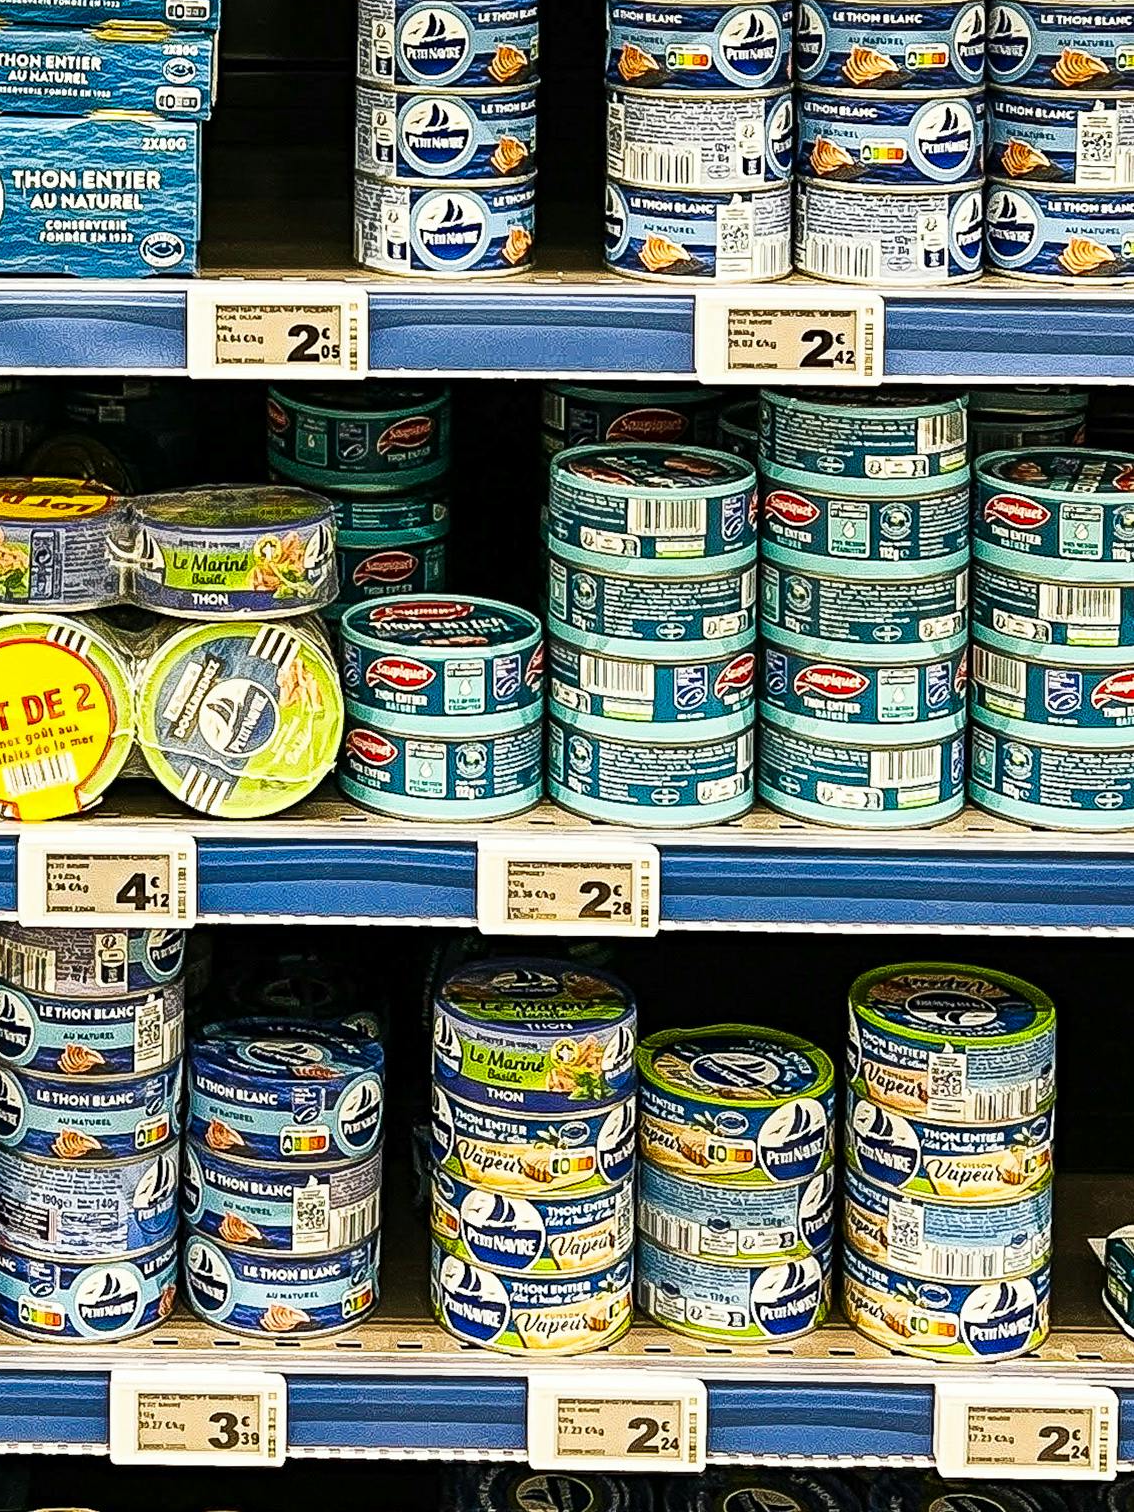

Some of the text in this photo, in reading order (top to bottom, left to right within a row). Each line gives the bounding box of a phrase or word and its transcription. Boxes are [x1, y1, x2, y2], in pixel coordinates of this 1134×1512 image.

[12, 170, 161, 189] THON ENTIER
[30, 191, 143, 210] AU NATUREL
[287, 324, 340, 362] 2 05
[800, 329, 854, 368] 2 42
[191, 554, 247, 572] Mariné
[192, 593, 228, 605] THON
[24, 692, 64, 726] DE
[76, 683, 96, 712] 2
[116, 873, 169, 910] 4 12
[579, 881, 631, 918] 2 28
[208, 1413, 259, 1449] 3 39
[627, 1418, 678, 1453] 2 24
